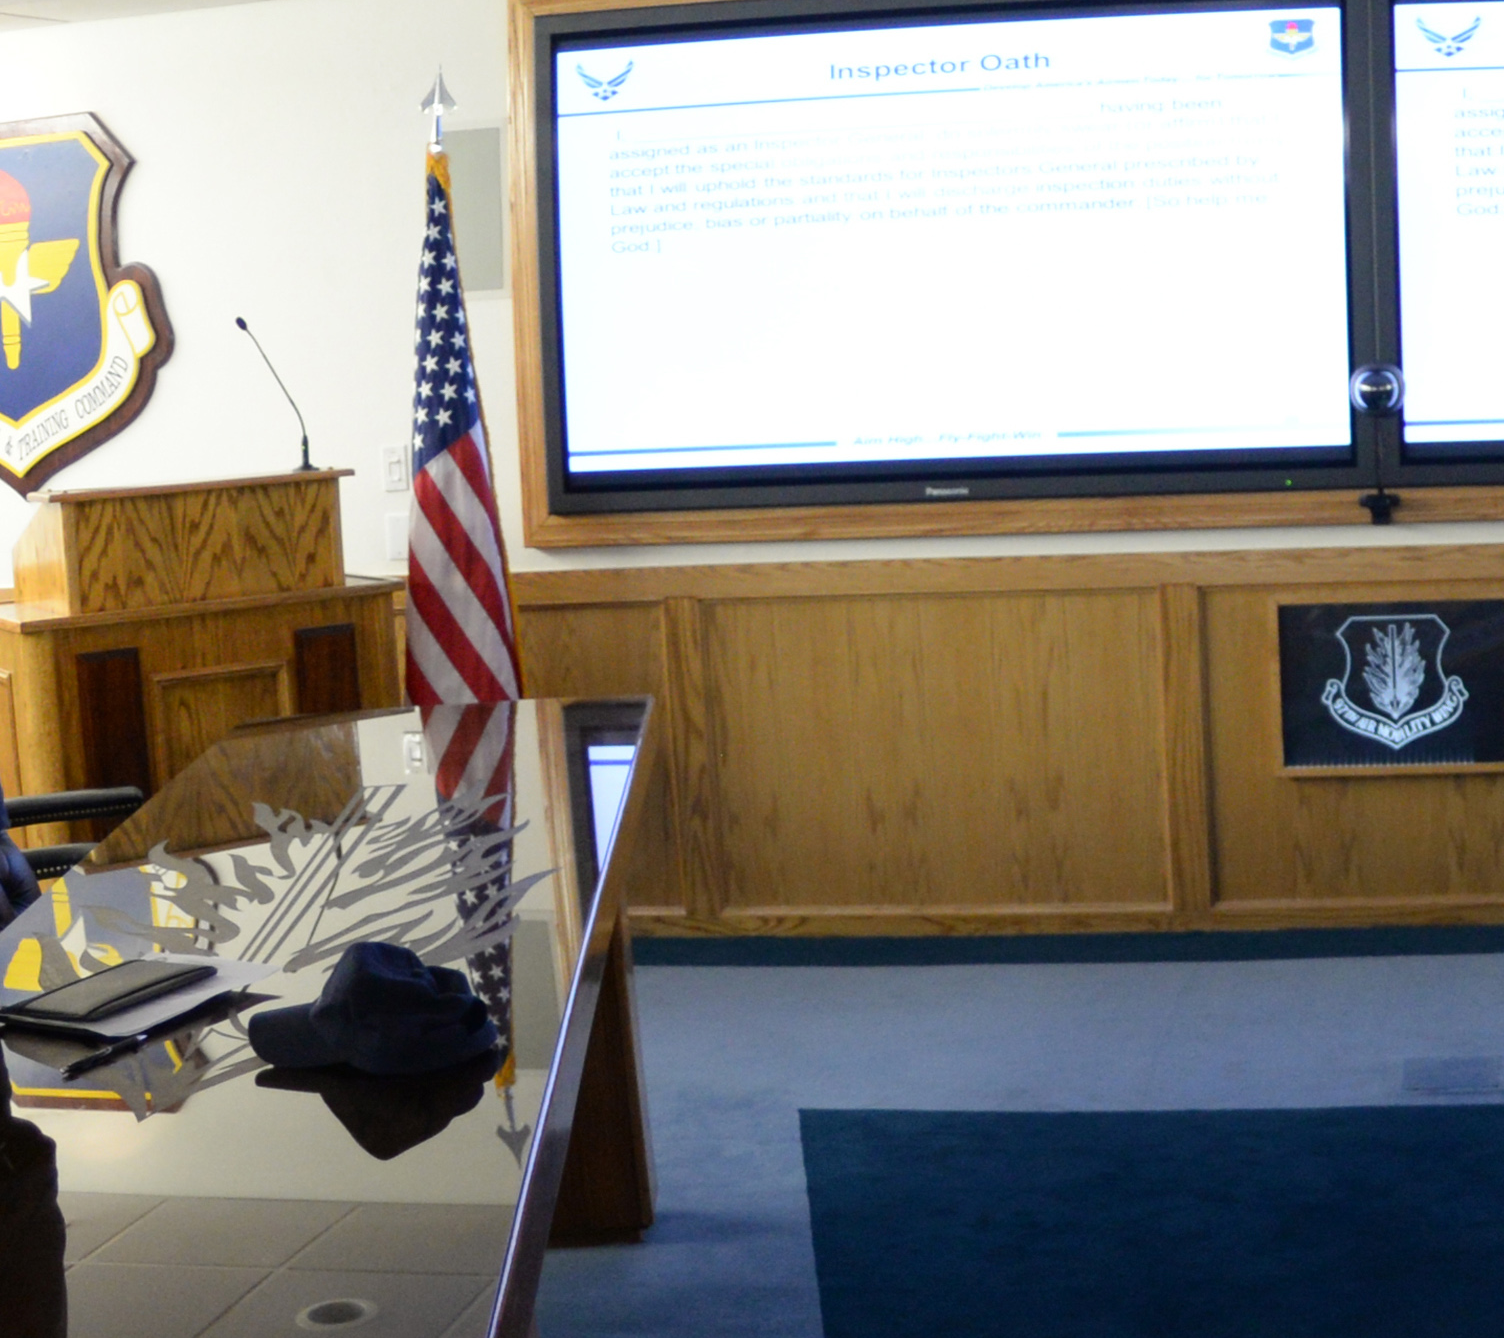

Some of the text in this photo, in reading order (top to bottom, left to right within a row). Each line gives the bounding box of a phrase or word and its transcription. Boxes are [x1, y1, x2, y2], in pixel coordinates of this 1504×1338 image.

[830, 52, 1050, 82] Inspector Oath
[1100, 96, 1222, 118] having been
[609, 142, 690, 164] assigned
[697, 144, 715, 154] as
[725, 142, 747, 152] an
[755, 133, 839, 154] Inspector
[1455, 143, 1491, 157] that
[610, 162, 672, 183] accept
[675, 160, 702, 175] the
[711, 156, 775, 176] special
[610, 183, 642, 197] that
[661, 180, 686, 194] will
[696, 176, 756, 196] uphold
[765, 173, 792, 188] the
[800, 168, 893, 185] standards
[899, 166, 923, 180] for
[932, 161, 1031, 182] Inspectors
[1039, 157, 1116, 173] General
[1124, 153, 1229, 173] prescribed
[1236, 151, 1259, 169] by
[1456, 163, 1497, 176] Law
[611, 201, 648, 216] Law
[654, 199, 686, 213] and
[694, 192, 794, 215] regulations
[803, 190, 836, 204] and
[844, 188, 878, 202] that
[899, 185, 925, 199] will
[935, 180, 1028, 201] discharge
[1036, 176, 1134, 196] inspection
[1143, 173, 1200, 188] duties
[1211, 170, 1280, 185] without
[706, 214, 743, 229] bias
[750, 217, 766, 226] or
[774, 209, 851, 229] partiality
[860, 210, 883, 221] on
[890, 204, 947, 219] behalf
[956, 203, 972, 216] of
[980, 201, 1009, 215] the
[1187, 192, 1227, 210] help
[1236, 194, 1267, 204] me
[17, 409, 69, 460] TRAINING
[74, 355, 129, 419] COMMAND
[1356, 717, 1377, 733] AIR
[1377, 715, 1431, 742] MOBILITY
[1431, 692, 1457, 723] WING
